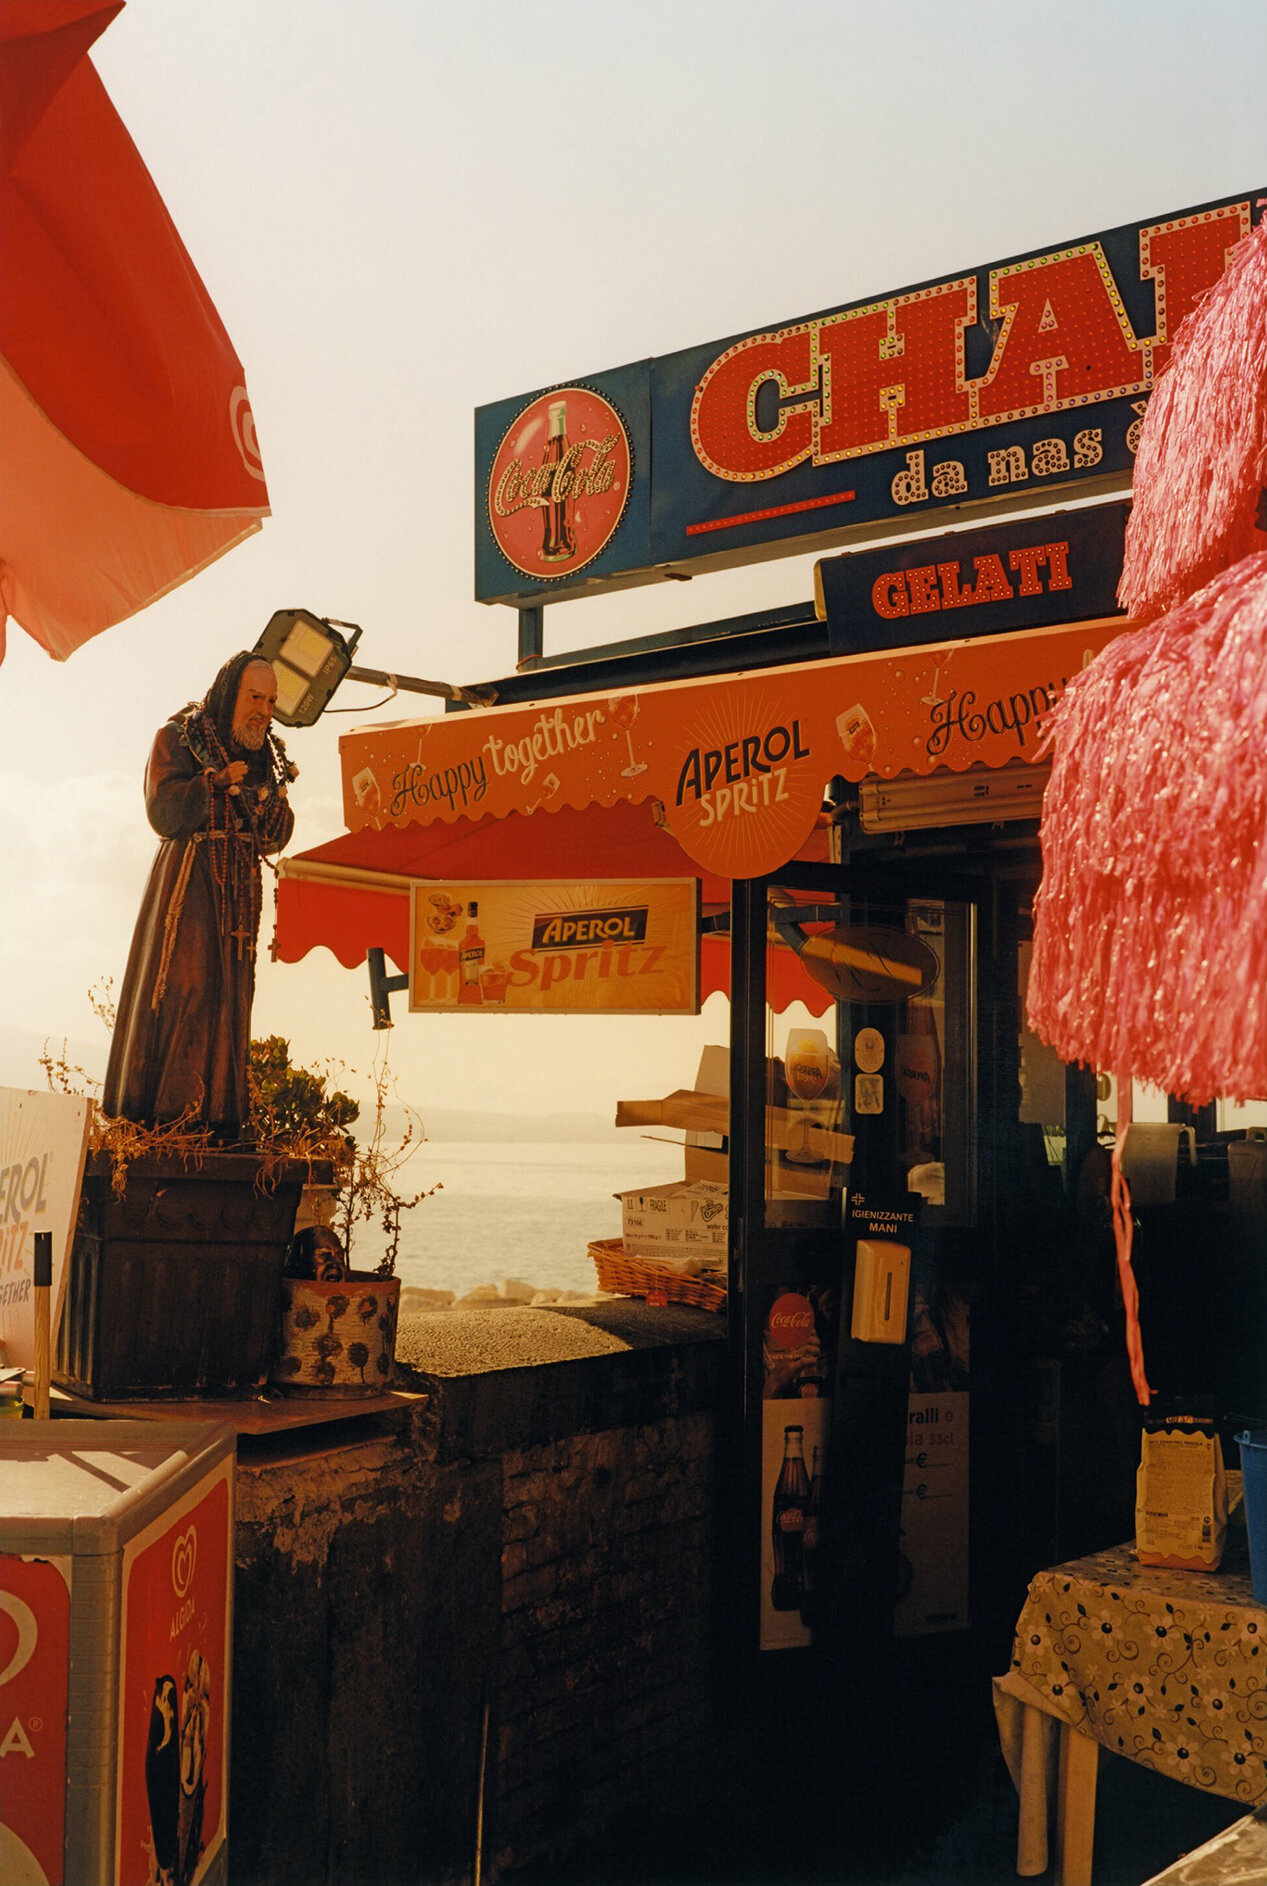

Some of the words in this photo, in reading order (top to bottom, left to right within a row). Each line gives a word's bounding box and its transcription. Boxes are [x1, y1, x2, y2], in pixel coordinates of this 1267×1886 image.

[495, 432, 622, 517] Coca-Cola
[891, 450, 968, 506] da
[988, 428, 1104, 487] nas
[872, 541, 1073, 620] GELATI
[390, 756, 489, 817] Happy
[482, 708, 606, 786] together
[676, 719, 811, 808] APEROL
[541, 915, 636, 944] APEROL
[507, 939, 668, 992] Spritz
[649, 1199, 667, 1212] FRAGILE
[852, 1209, 914, 1223] IGIENIZZANTE
[869, 1222, 898, 1233] MANI
[906, 1431, 924, 1446] la
[928, 1432, 954, 1446] 33cl
